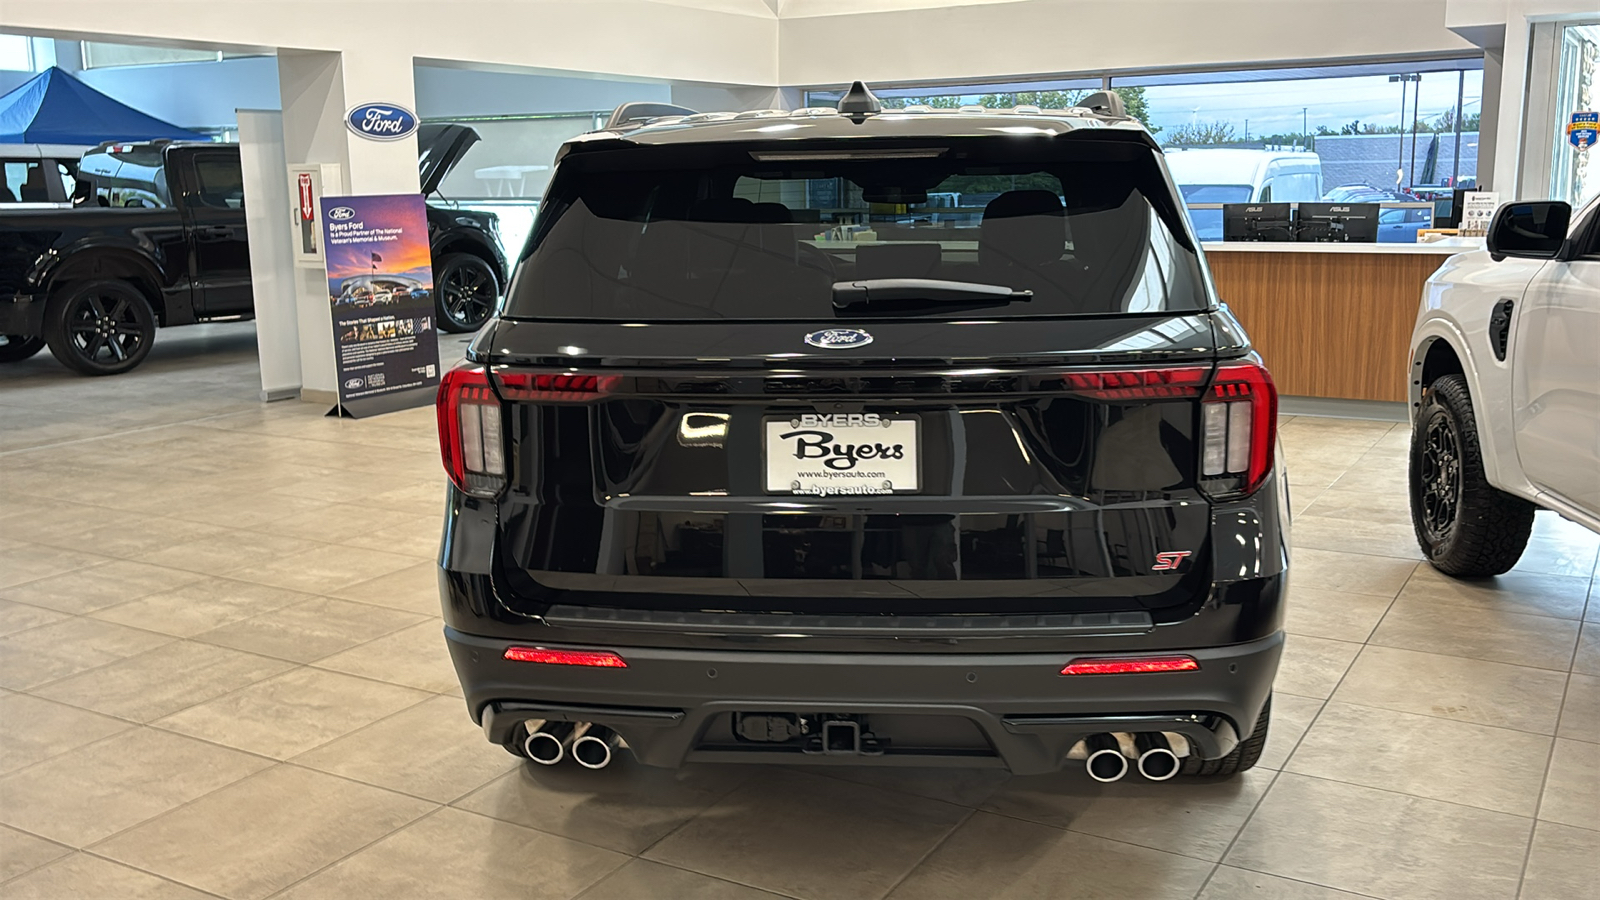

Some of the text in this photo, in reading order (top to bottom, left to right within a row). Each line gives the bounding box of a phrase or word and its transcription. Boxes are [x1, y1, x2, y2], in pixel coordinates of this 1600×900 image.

[362, 108, 403, 133] Ford
[334, 208, 350, 219] Ford
[330, 222, 364, 232] Byers Ford
[820, 330, 858, 344] Ford
[800, 414, 881, 428] BYERS
[778, 430, 904, 470] Byers
[798, 470, 886, 480] www.byersauto.com
[792, 484, 894, 497] www.byersauto.com
[1151, 550, 1192, 570] ST
